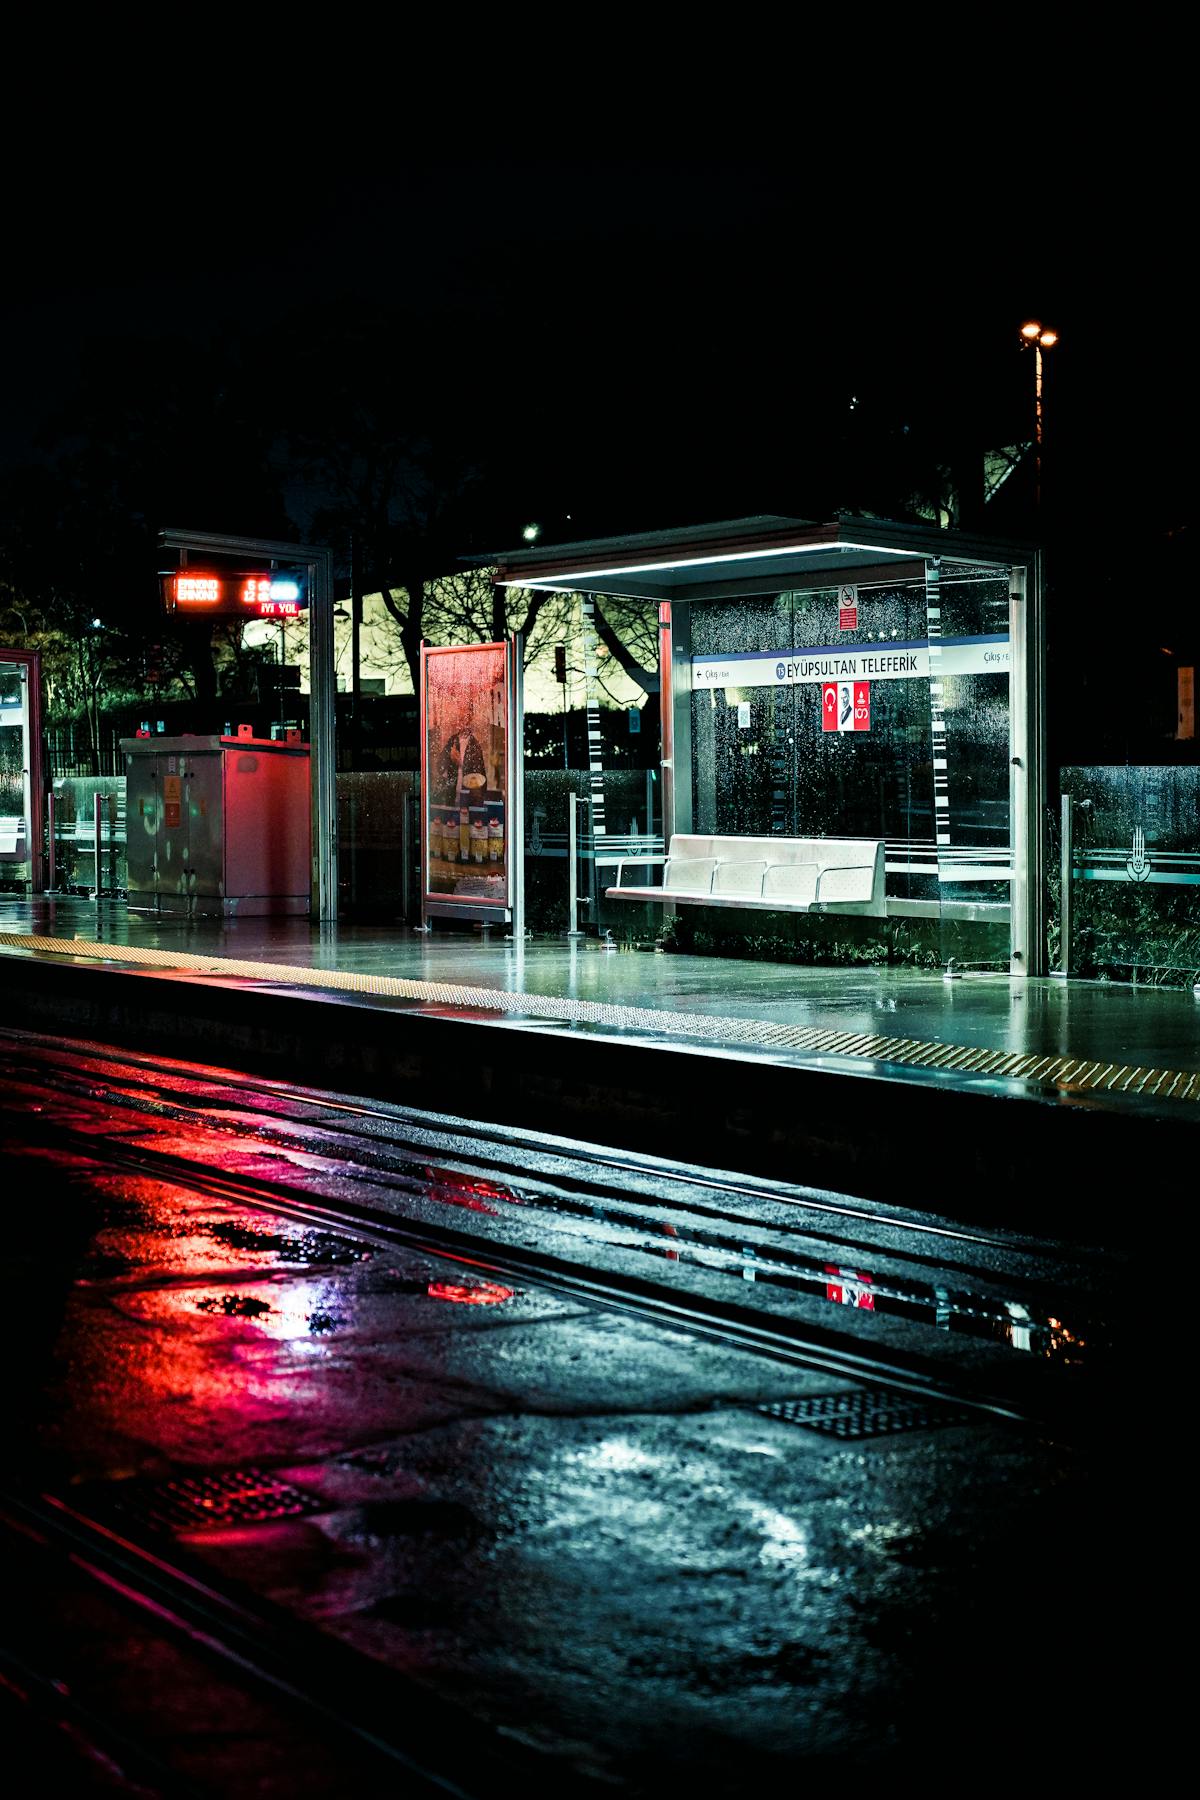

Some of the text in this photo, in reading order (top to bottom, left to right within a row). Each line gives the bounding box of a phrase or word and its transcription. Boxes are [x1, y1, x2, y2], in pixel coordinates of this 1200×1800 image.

[279, 603, 296, 613] YOL
[984, 652, 1001, 664] Çıkış
[787, 659, 856, 678] EYÜPSULTAN
[861, 652, 918, 673] TELEFERİK
